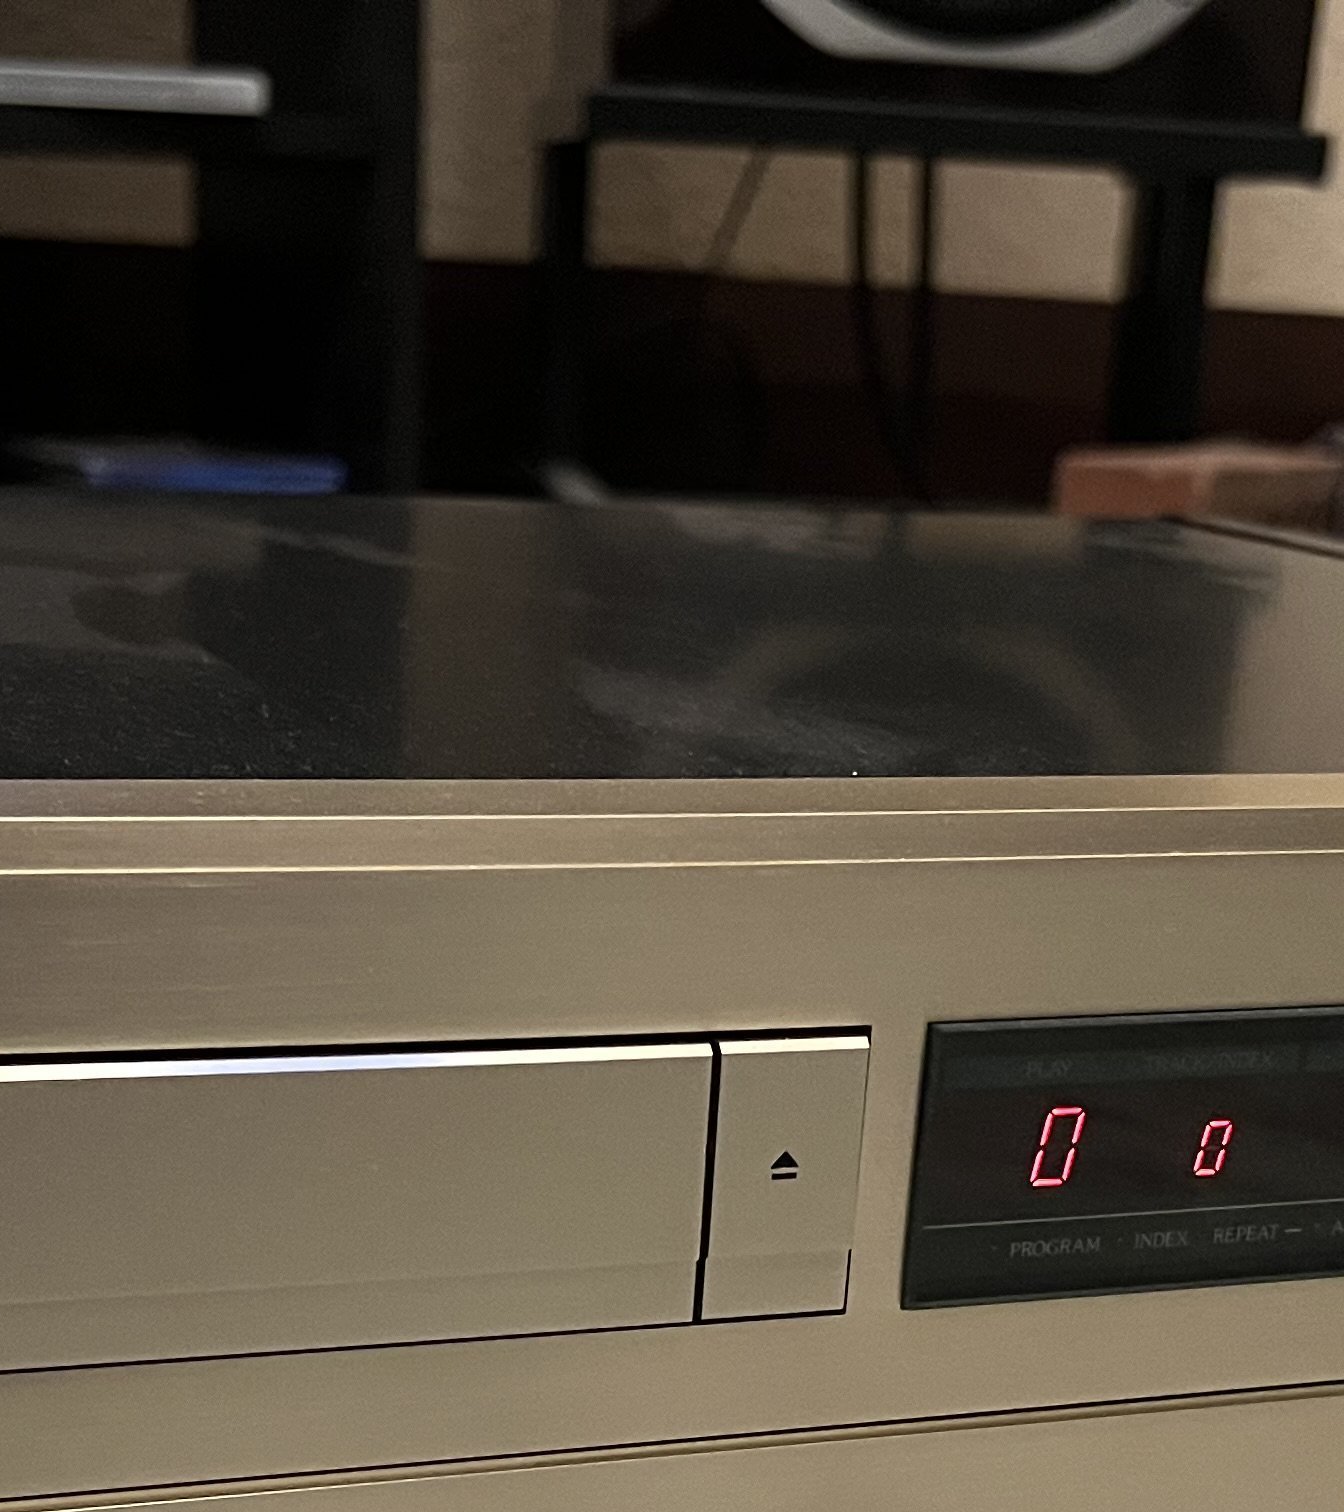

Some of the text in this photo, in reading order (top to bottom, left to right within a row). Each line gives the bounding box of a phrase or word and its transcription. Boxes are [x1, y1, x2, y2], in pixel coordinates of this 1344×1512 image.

[1029, 1106, 1234, 1188] 0 0
[1009, 1237, 1101, 1259] PROGRAM
[1133, 1230, 1190, 1250] INDEX
[1212, 1224, 1280, 1244] REPEAT
